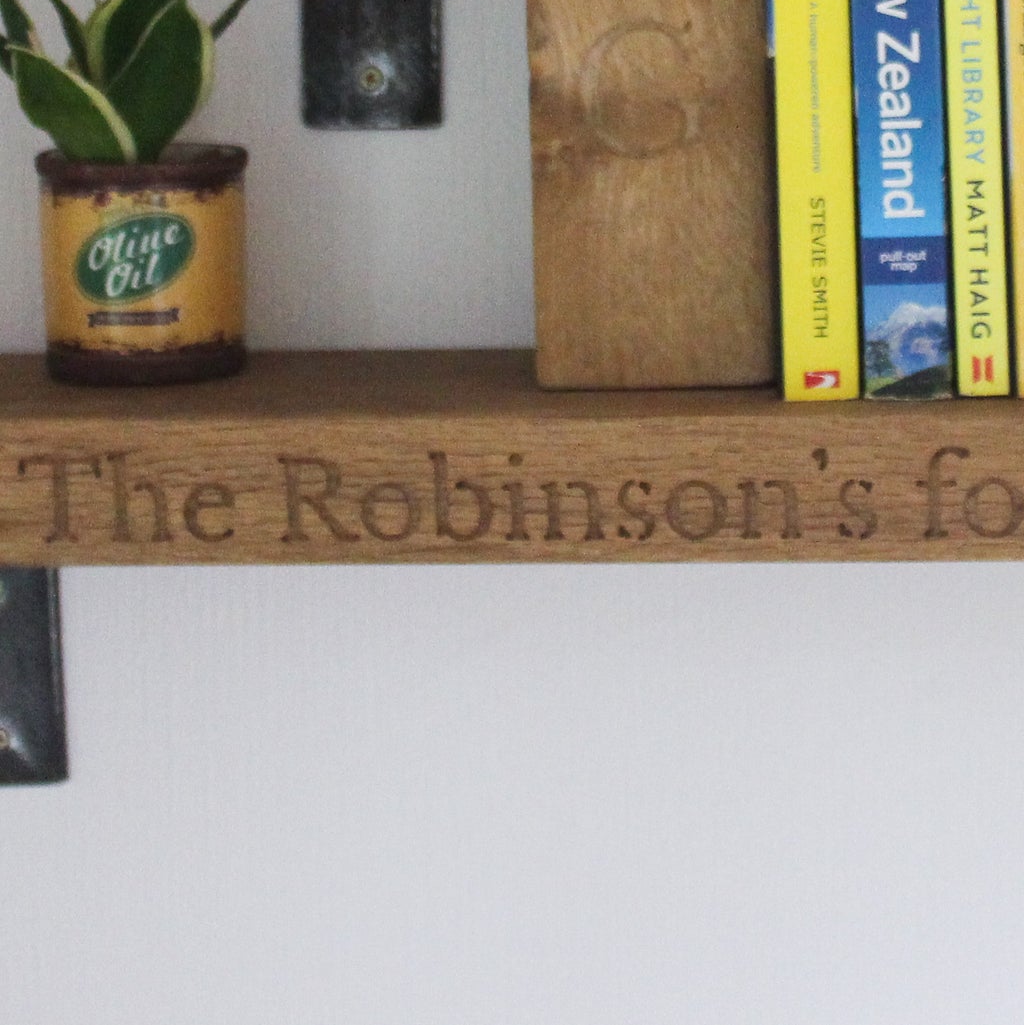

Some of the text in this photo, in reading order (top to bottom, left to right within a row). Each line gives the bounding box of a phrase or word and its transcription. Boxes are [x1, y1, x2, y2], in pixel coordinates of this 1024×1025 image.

[877, 31, 926, 219] Zealand
[960, 40, 986, 165] LIBRARY
[105, 253, 160, 297] Oil
[810, 197, 828, 339] STEVIE SMITH
[879, 251, 928, 265] pull-out
[890, 262, 918, 273] map
[966, 180, 992, 339] MATT HAIG
[18, 450, 236, 544] The
[278, 447, 880, 543] Robinson's
